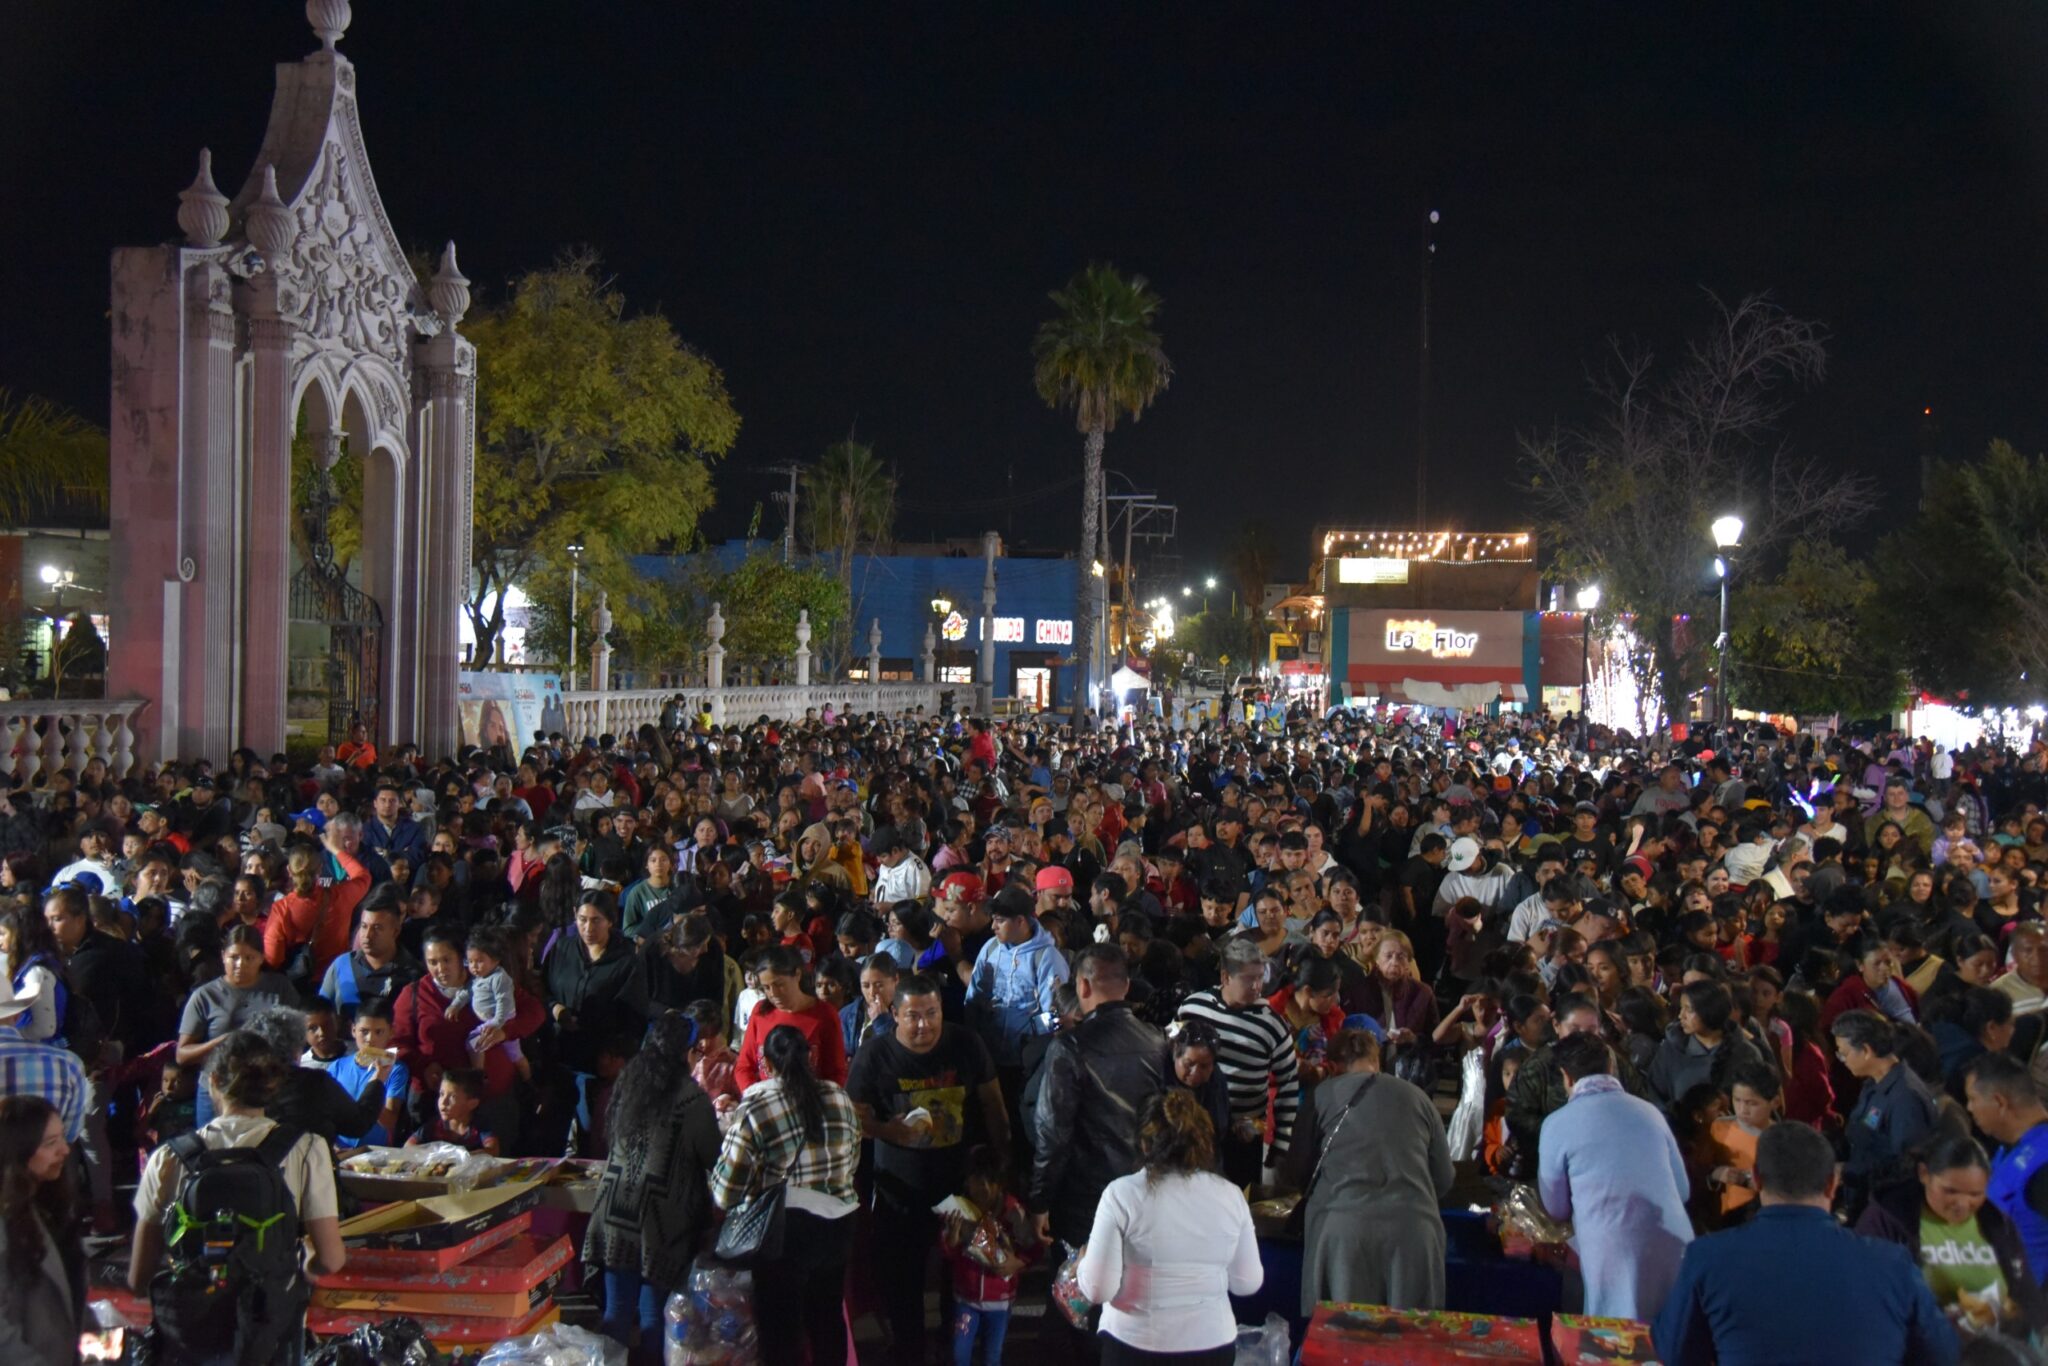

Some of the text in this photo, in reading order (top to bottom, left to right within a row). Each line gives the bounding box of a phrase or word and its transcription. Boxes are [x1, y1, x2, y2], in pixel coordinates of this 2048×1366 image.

[1038, 621, 1070, 642] CHINA
[1388, 630, 1476, 650] La Flor
[1921, 1239, 1998, 1265] adida
